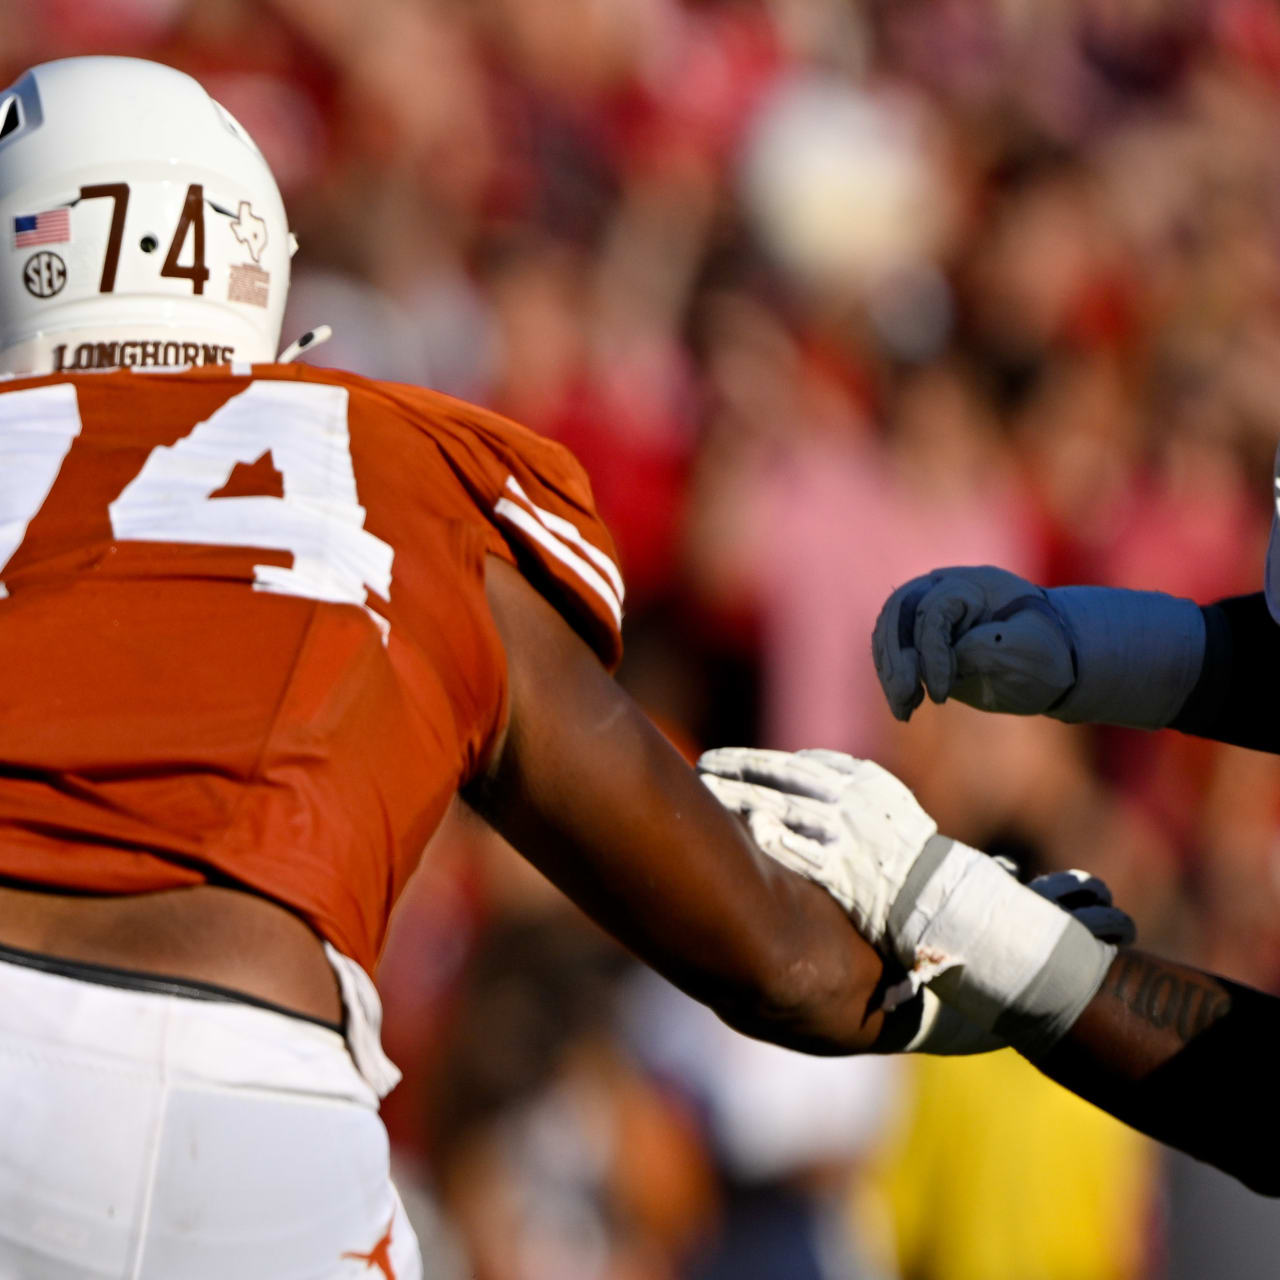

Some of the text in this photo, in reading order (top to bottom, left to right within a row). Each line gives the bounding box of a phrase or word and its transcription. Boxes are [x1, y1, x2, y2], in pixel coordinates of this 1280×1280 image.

[81, 183, 209, 295] 74
[26, 253, 66, 297] SEC
[53, 340, 235, 372] LONGHORNS
